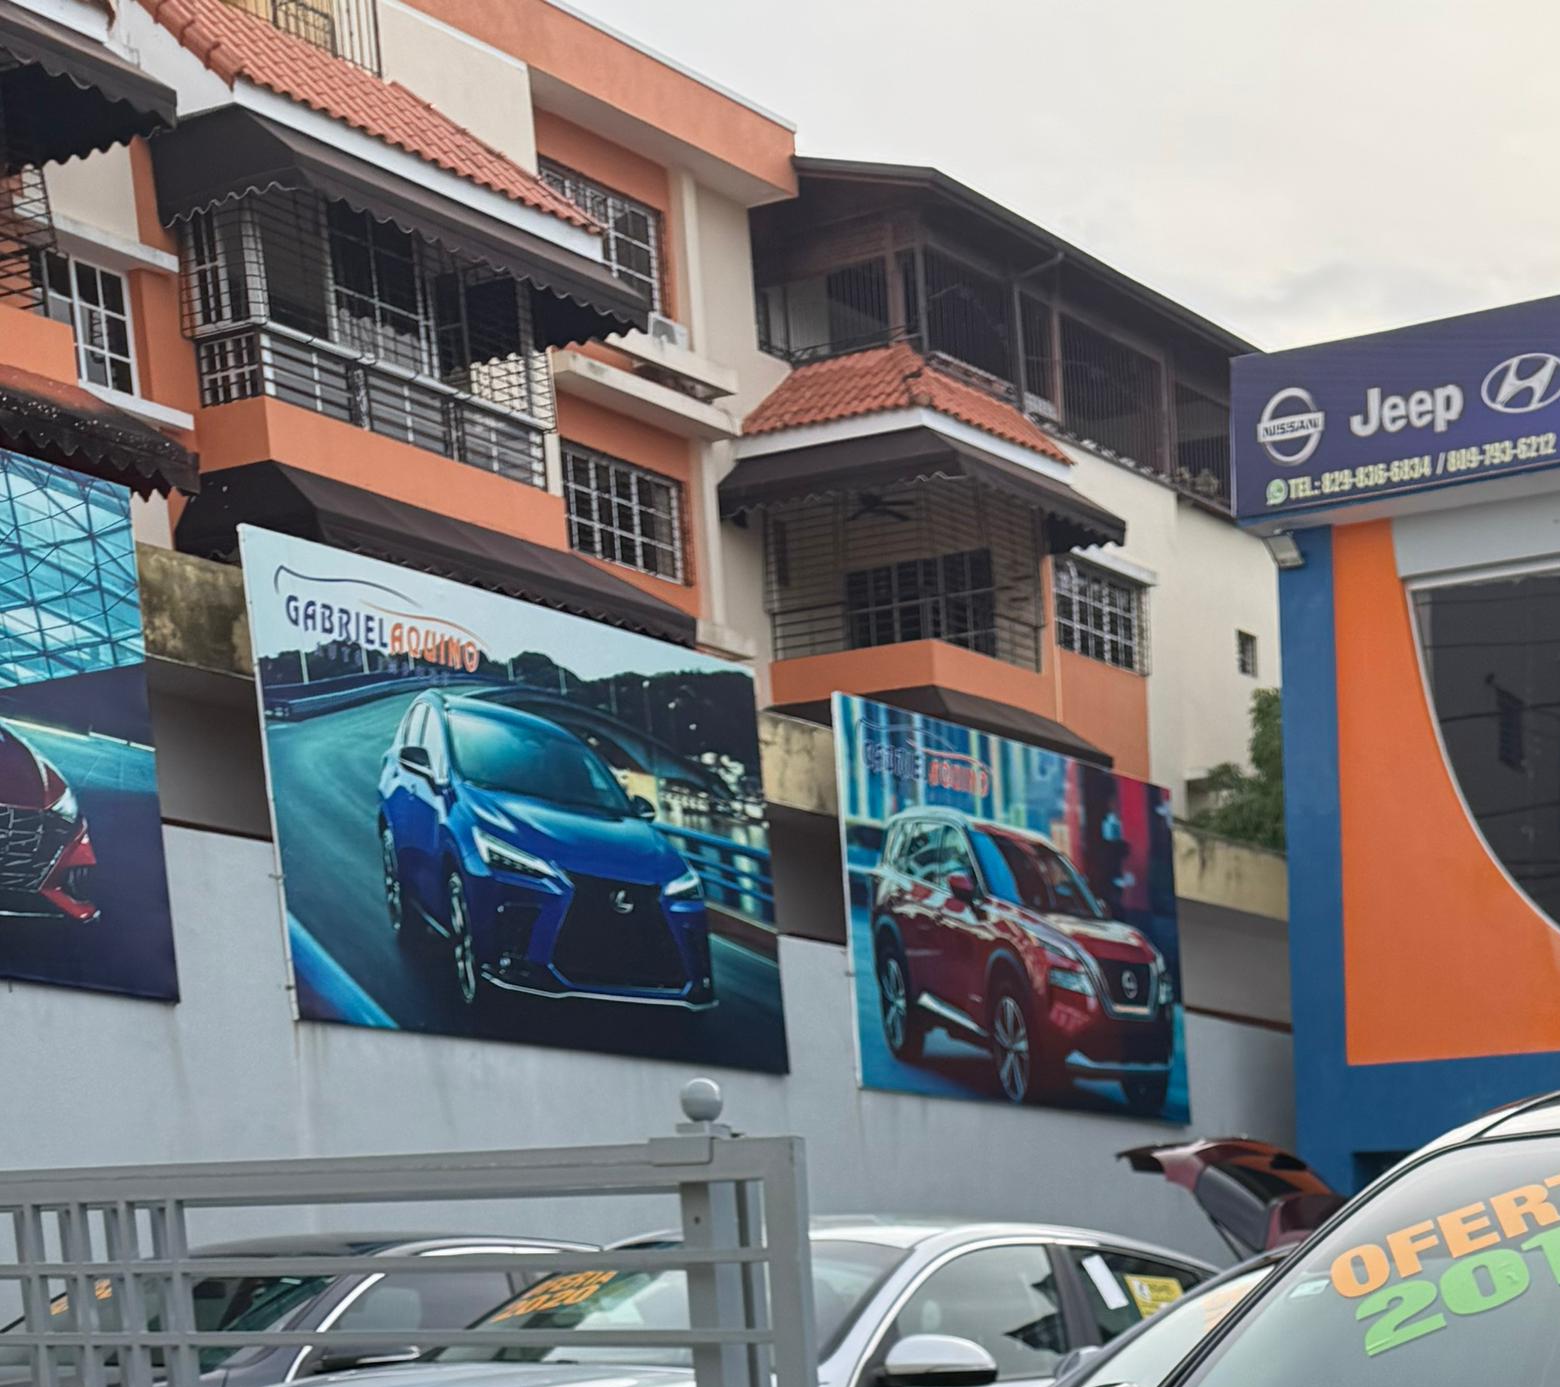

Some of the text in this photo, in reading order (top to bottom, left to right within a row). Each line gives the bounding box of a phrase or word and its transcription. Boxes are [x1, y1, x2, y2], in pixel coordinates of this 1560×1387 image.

[1262, 417, 1321, 438] NISSAN
[1349, 383, 1465, 437] Jeep
[285, 594, 480, 674] GABRIEL AQUINO
